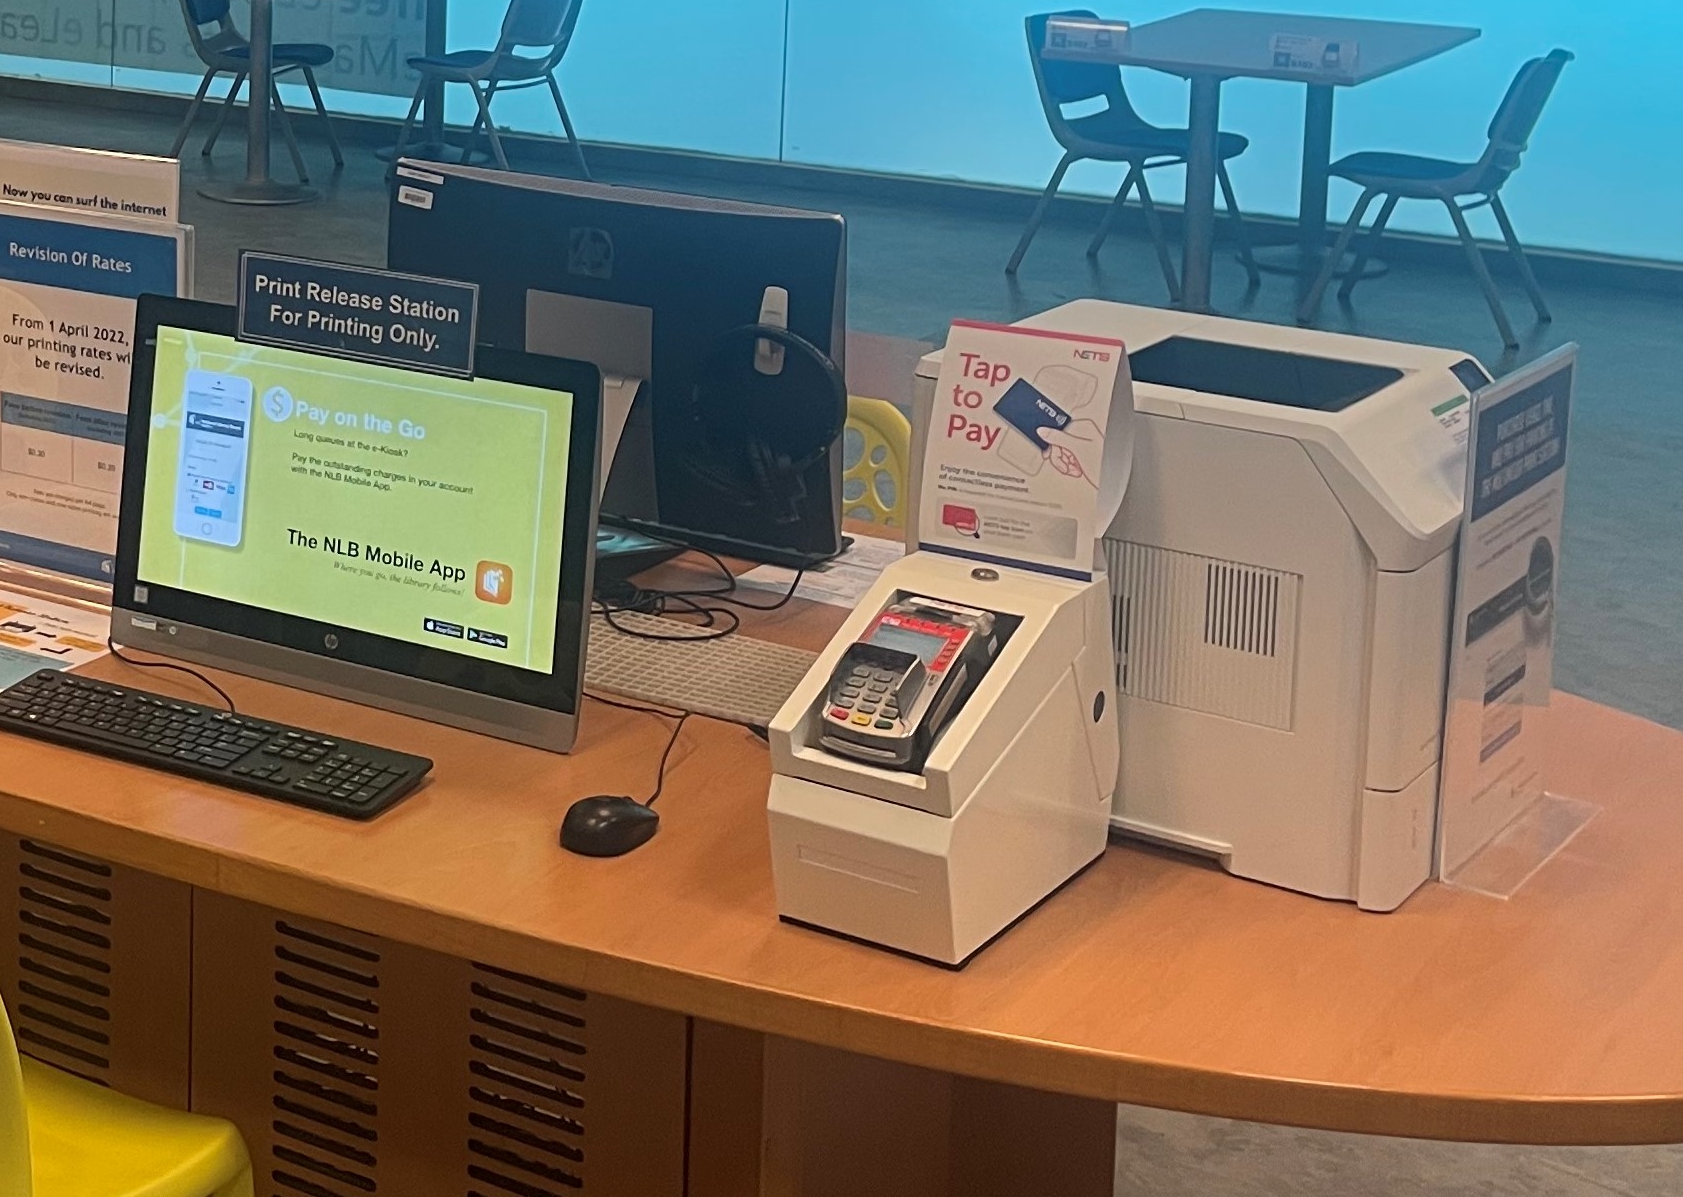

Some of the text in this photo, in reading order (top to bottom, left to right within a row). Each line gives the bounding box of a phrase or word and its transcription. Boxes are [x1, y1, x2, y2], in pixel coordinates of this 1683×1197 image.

[3, 183, 166, 217] Now you can surf the internet
[9, 242, 131, 273] Revision Of Rates
[255, 274, 459, 323] Print Release Station
[12, 314, 129, 346] From 1 April 2022,
[270, 304, 440, 352] For Printing Only.
[3, 334, 130, 364] our printing rates wi
[35, 355, 105, 379] be revised.
[960, 353, 1011, 387] Tap
[953, 384, 983, 408] to
[296, 401, 425, 439] Pay on the Go
[947, 414, 1001, 450] Pay
[294, 429, 408, 457] Long queues at the e-Kiosk?
[291, 466, 392, 492] with the NLB Mobile App.
[292, 453, 473, 494] Pay the outstanding charges in your account
[287, 528, 466, 583] The NLB Mobile App
